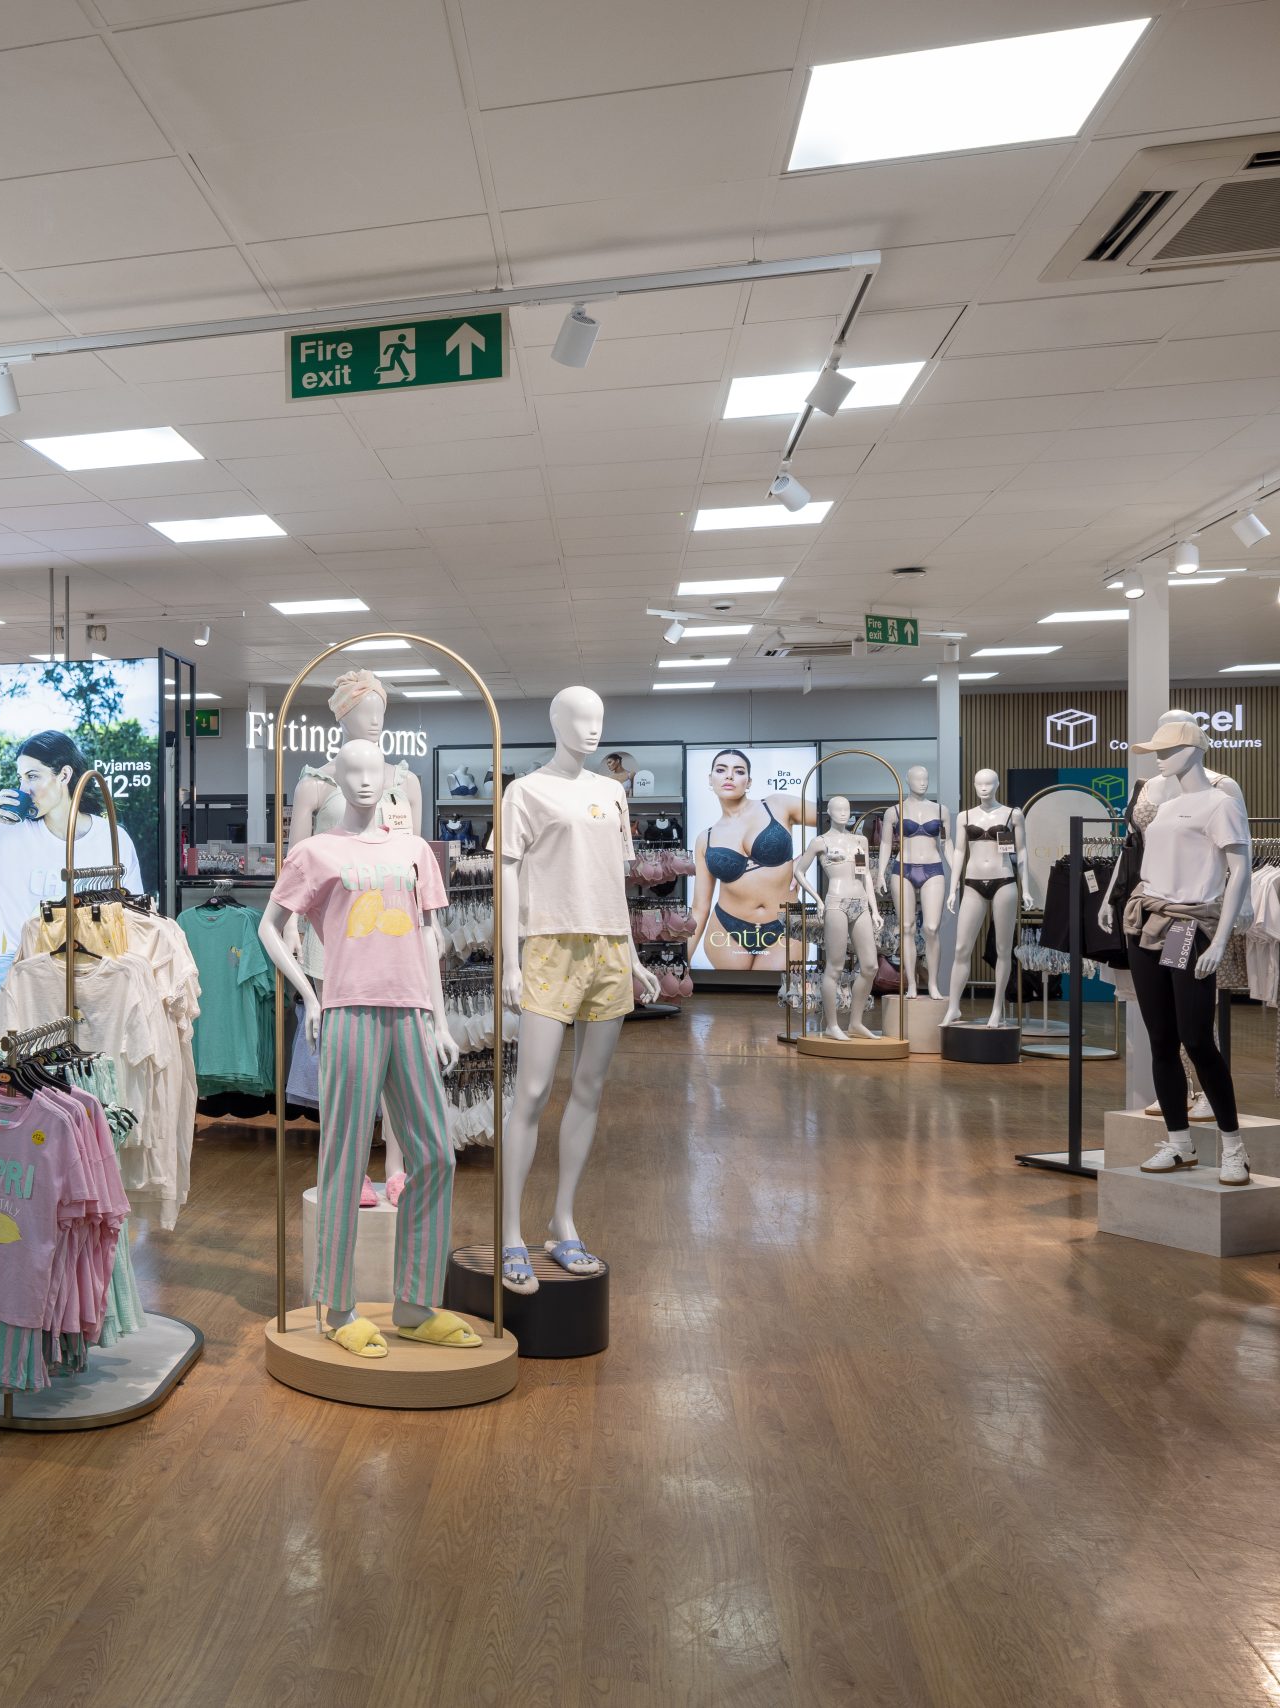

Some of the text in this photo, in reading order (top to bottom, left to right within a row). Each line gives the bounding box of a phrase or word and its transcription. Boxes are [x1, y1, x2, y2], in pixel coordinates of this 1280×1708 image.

[300, 340, 353, 363] Fire
[301, 364, 352, 389] exit
[867, 618, 882, 629] Fire
[868, 630, 882, 640] exit
[1192, 704, 1243, 731] cel
[248, 711, 427, 762] Fiting oms
[94, 759, 151, 774] Pyjamas
[94, 775, 151, 798] 12.50
[767, 778, 802, 791] £12.00
[1177, 926, 1195, 969] SO SCULPT
